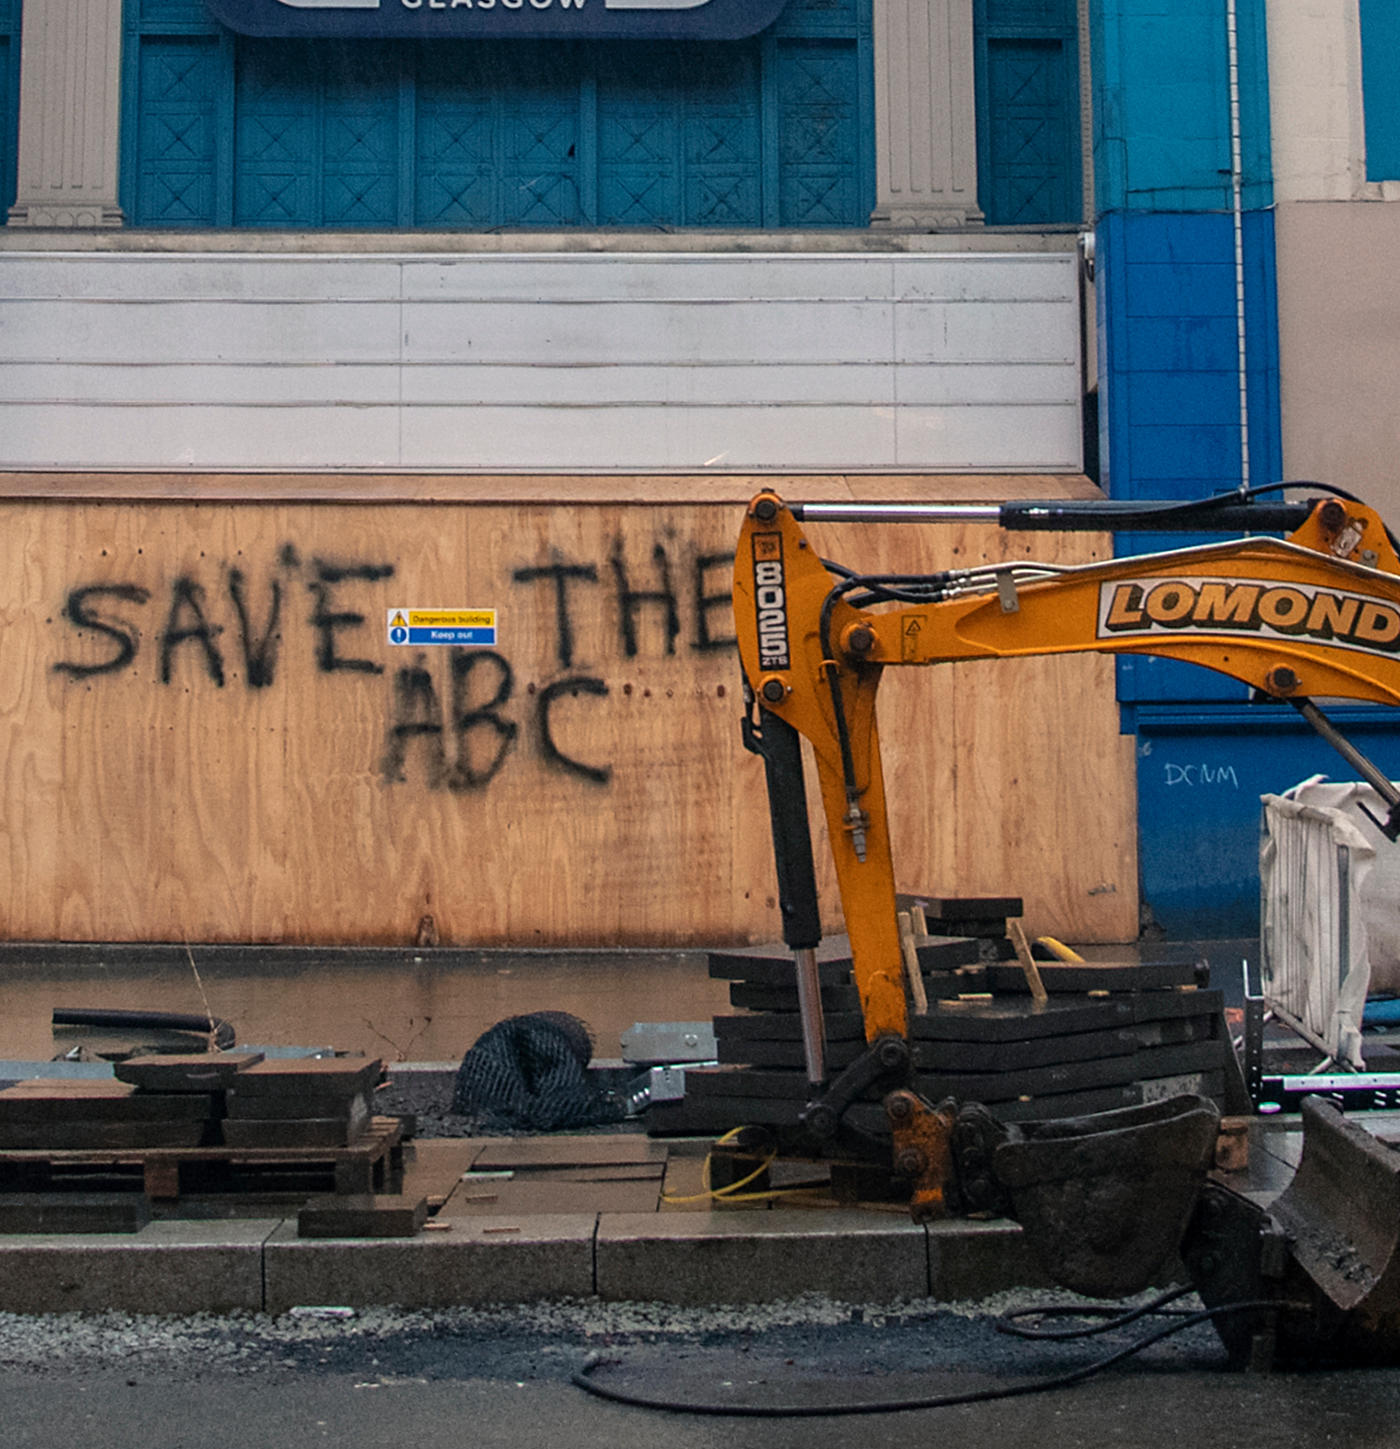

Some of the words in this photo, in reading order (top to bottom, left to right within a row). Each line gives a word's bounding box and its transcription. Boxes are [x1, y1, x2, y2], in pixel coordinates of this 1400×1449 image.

[50, 542, 396, 689] SAVE
[511, 530, 739, 668] THE
[412, 615, 456, 625] Dangerous
[458, 615, 491, 625] building
[431, 630, 455, 640] Keep
[457, 631, 473, 639] out
[756, 561, 787, 656] 8025
[380, 644, 610, 793] ABC
